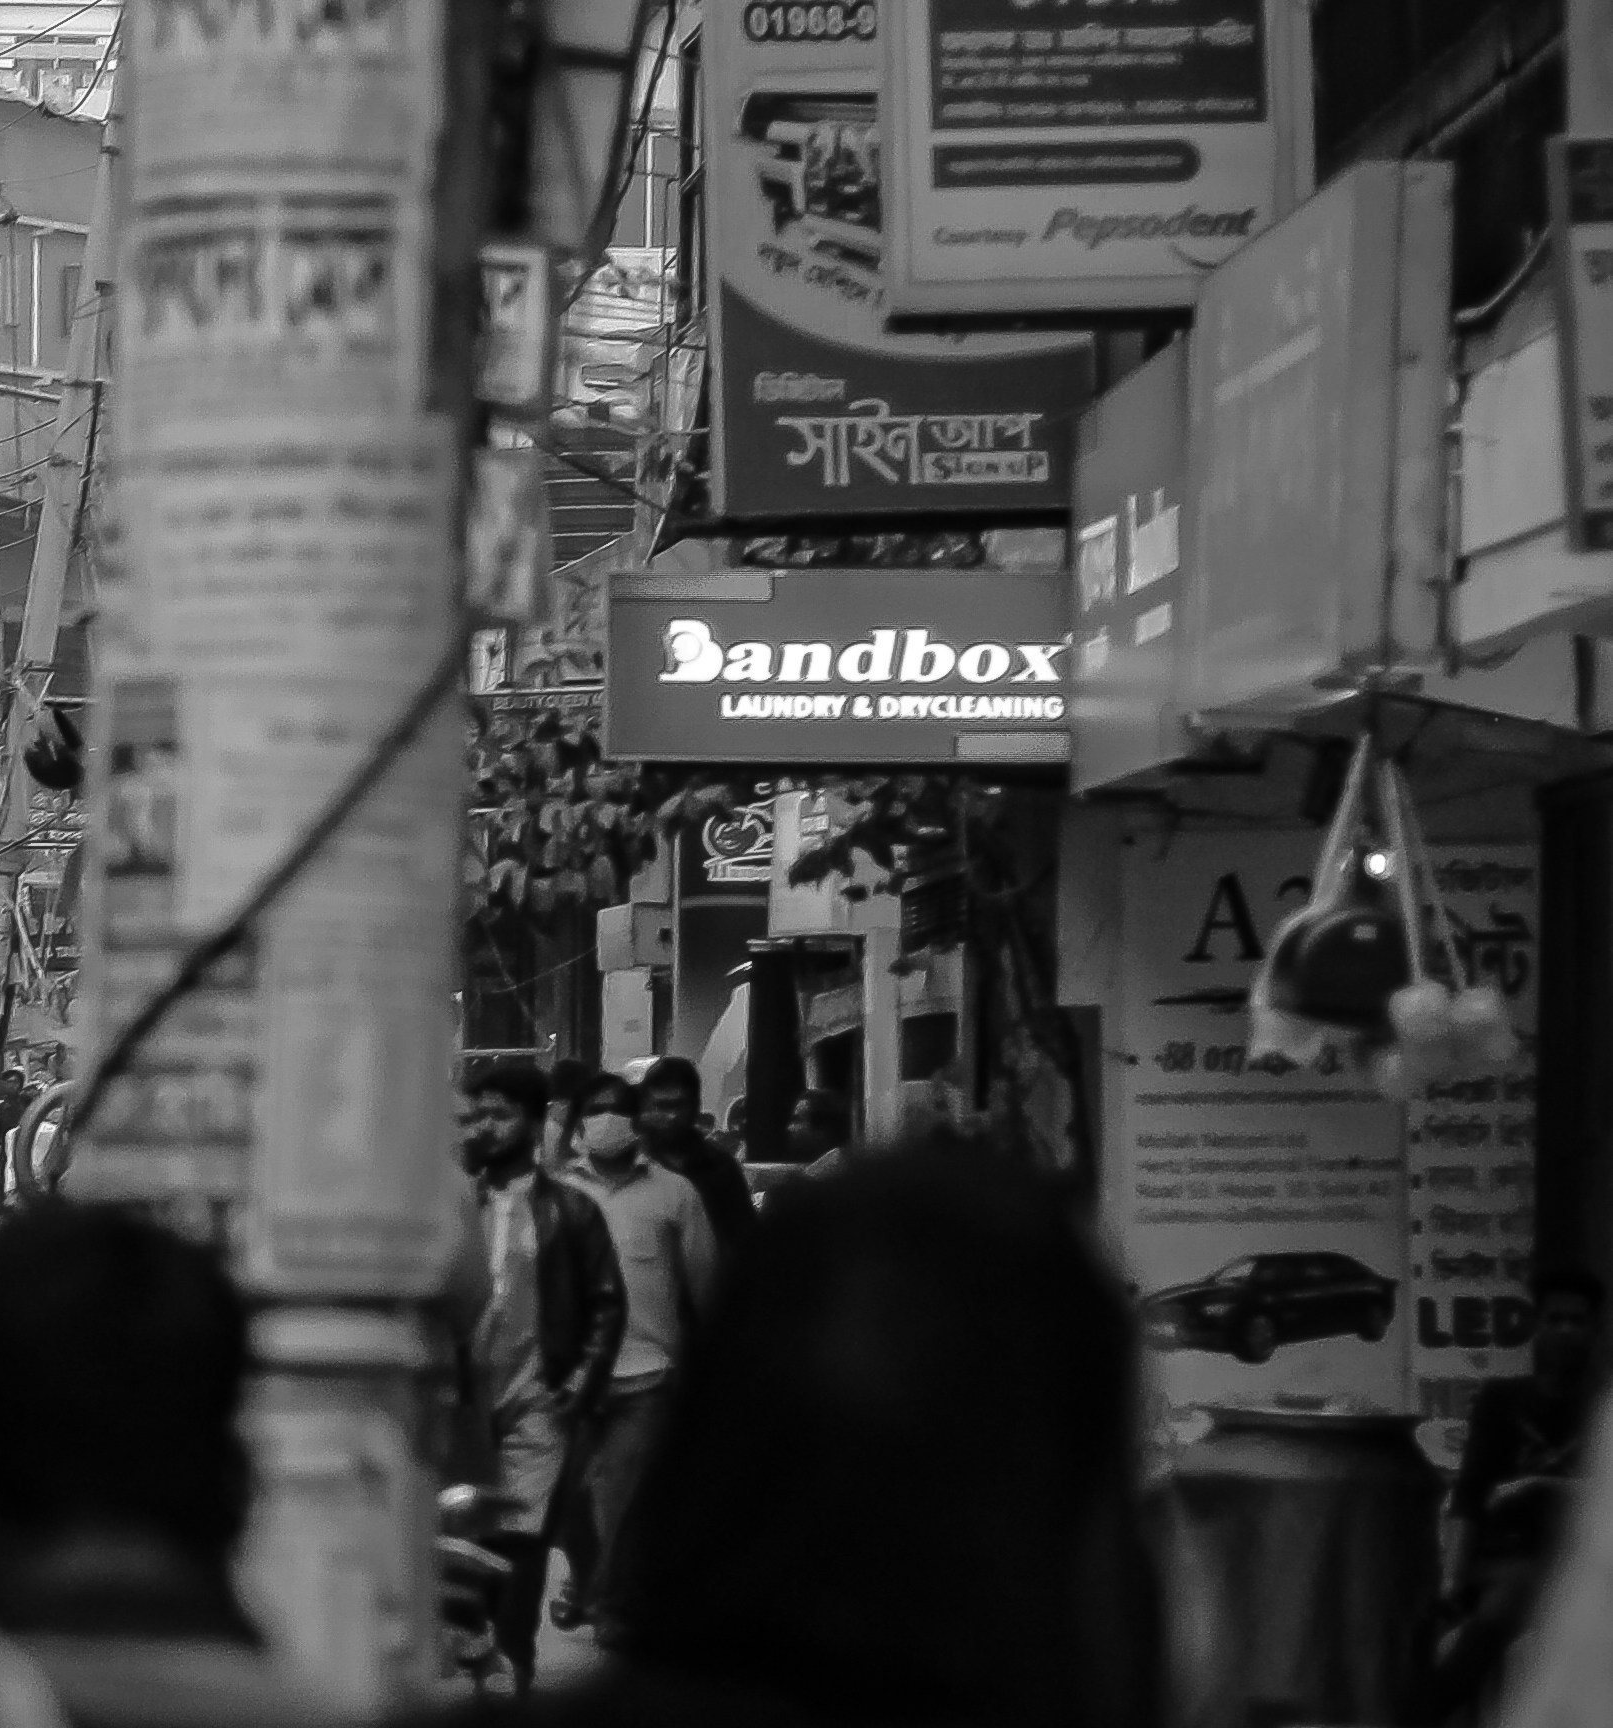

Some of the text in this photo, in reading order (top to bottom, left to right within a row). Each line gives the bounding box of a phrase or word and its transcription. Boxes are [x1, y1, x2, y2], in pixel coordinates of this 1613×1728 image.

[1041, 205, 1257, 250] Pepsodent
[775, 398, 1044, 488] সাইন আপ
[720, 693, 1066, 720] LAUNDRY & DRYCLEANING
[1417, 1295, 1535, 1349] LED
